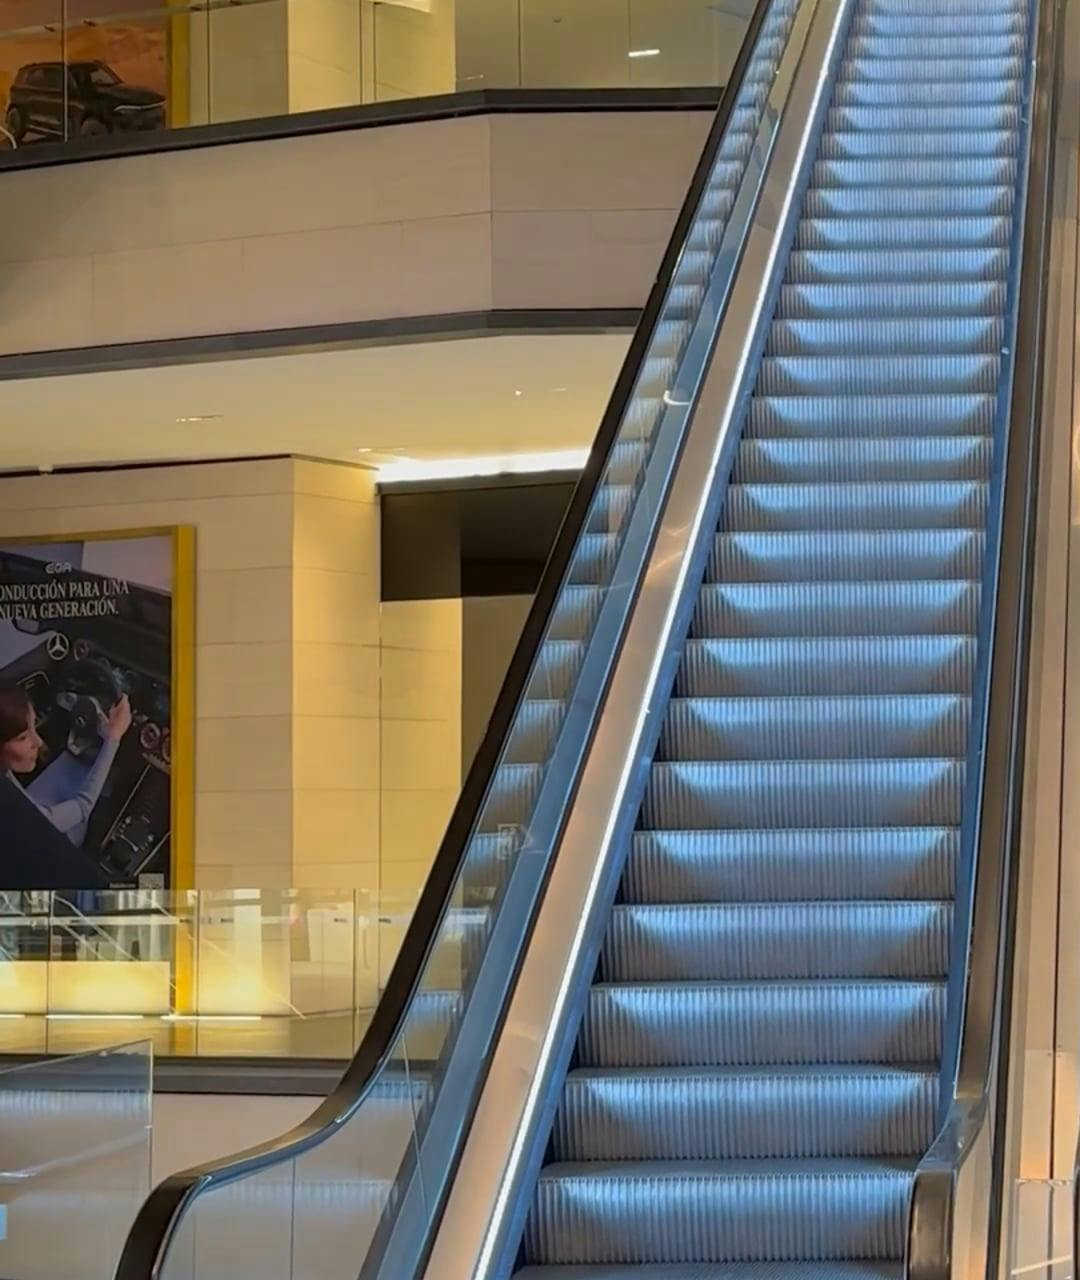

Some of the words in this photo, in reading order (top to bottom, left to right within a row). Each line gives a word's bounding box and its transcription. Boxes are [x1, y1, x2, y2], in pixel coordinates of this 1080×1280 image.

[69, 581, 100, 597] PARA
[103, 578, 129, 595] UNA
[40, 597, 119, 618] GENERACIÓN.
